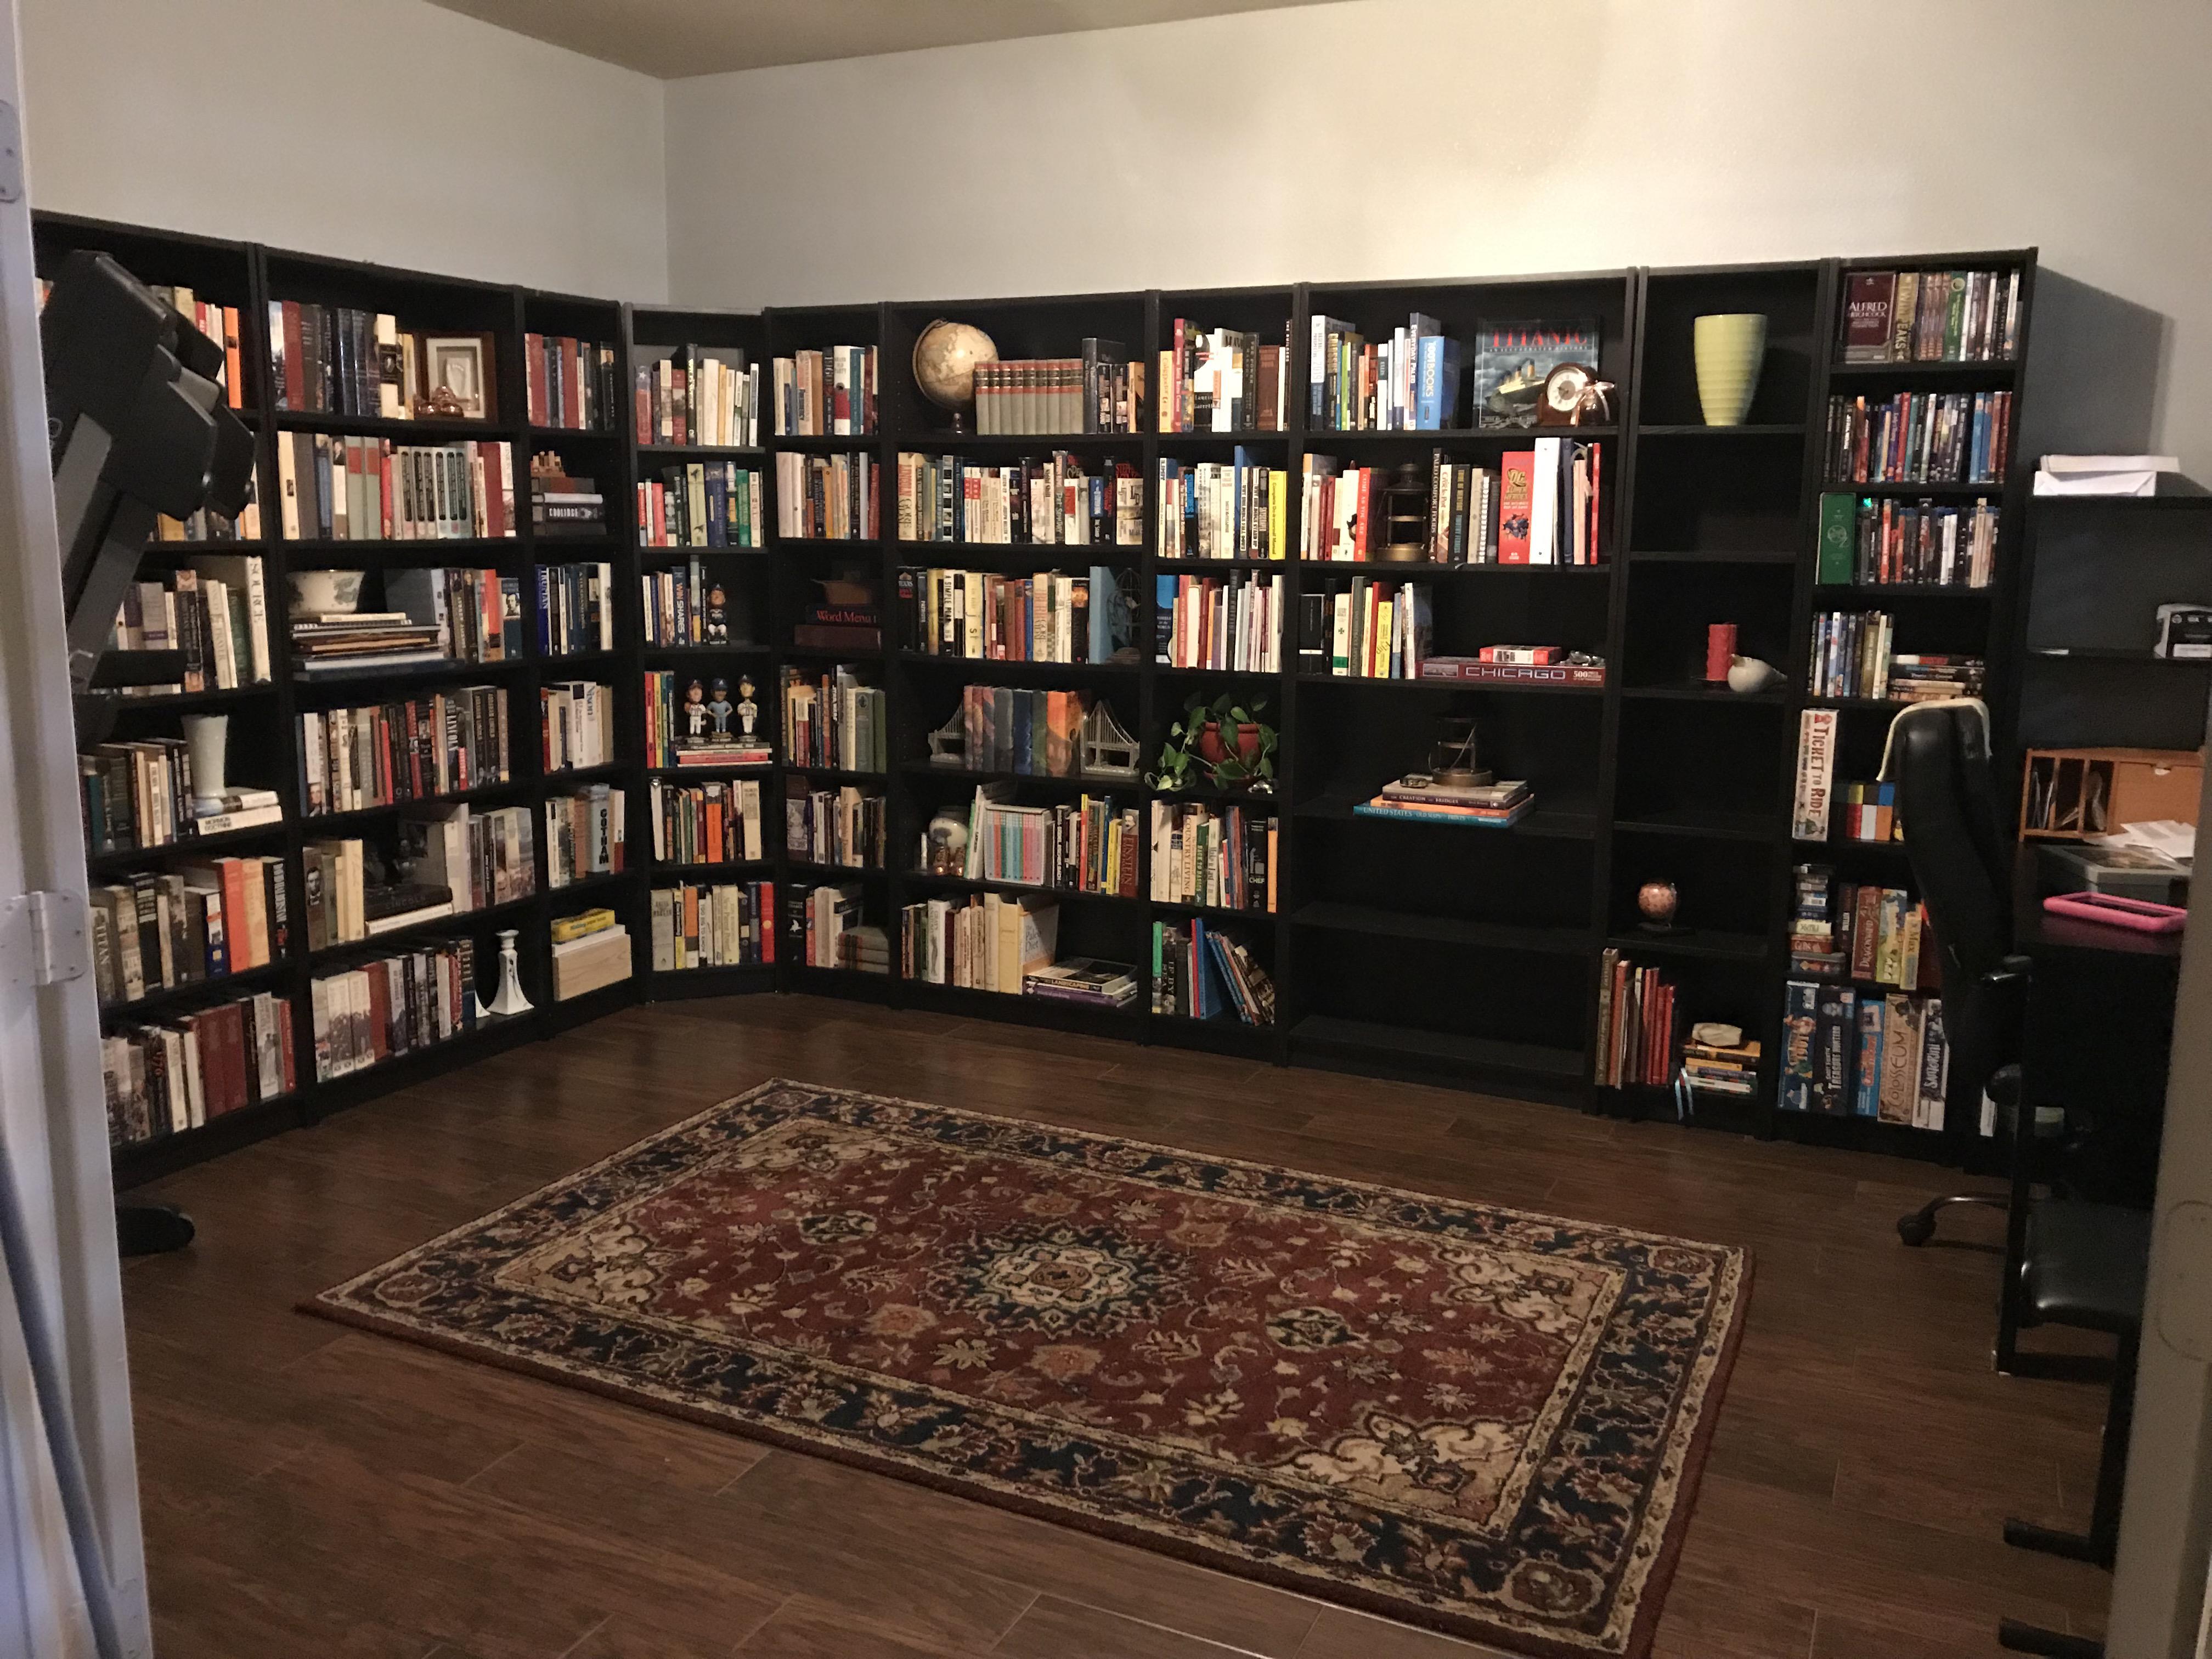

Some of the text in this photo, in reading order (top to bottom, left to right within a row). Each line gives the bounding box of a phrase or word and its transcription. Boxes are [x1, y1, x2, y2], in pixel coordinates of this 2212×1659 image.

[1848, 301, 1887, 312] ALFRED
[1491, 329, 1588, 347] TITANIC
[1895, 318, 1909, 349] PEAKS
[899, 464, 912, 496] LINCOLN
[549, 508, 578, 517] COOLIDGE
[1259, 506, 1267, 532] SKYSCRAPER
[676, 600, 685, 634] SHARES
[816, 610, 872, 623] Word Menu
[1465, 666, 1588, 680] CHICAGO 500
[586, 686, 595, 715] Nixon
[1808, 726, 1830, 817] TICKET TO RIDE
[1363, 807, 1389, 815] UNITED
[1389, 809, 1413, 817] STATES
[599, 809, 609, 864] GOTHAM
[1123, 837, 1134, 885] EINSTEIN
[96, 924, 110, 964] TITAN
[1827, 1053, 1842, 1090] TREASURE
[1887, 1030, 1907, 1108] COLOSSEUM
[1921, 1043, 1941, 1088] SANTORINI
